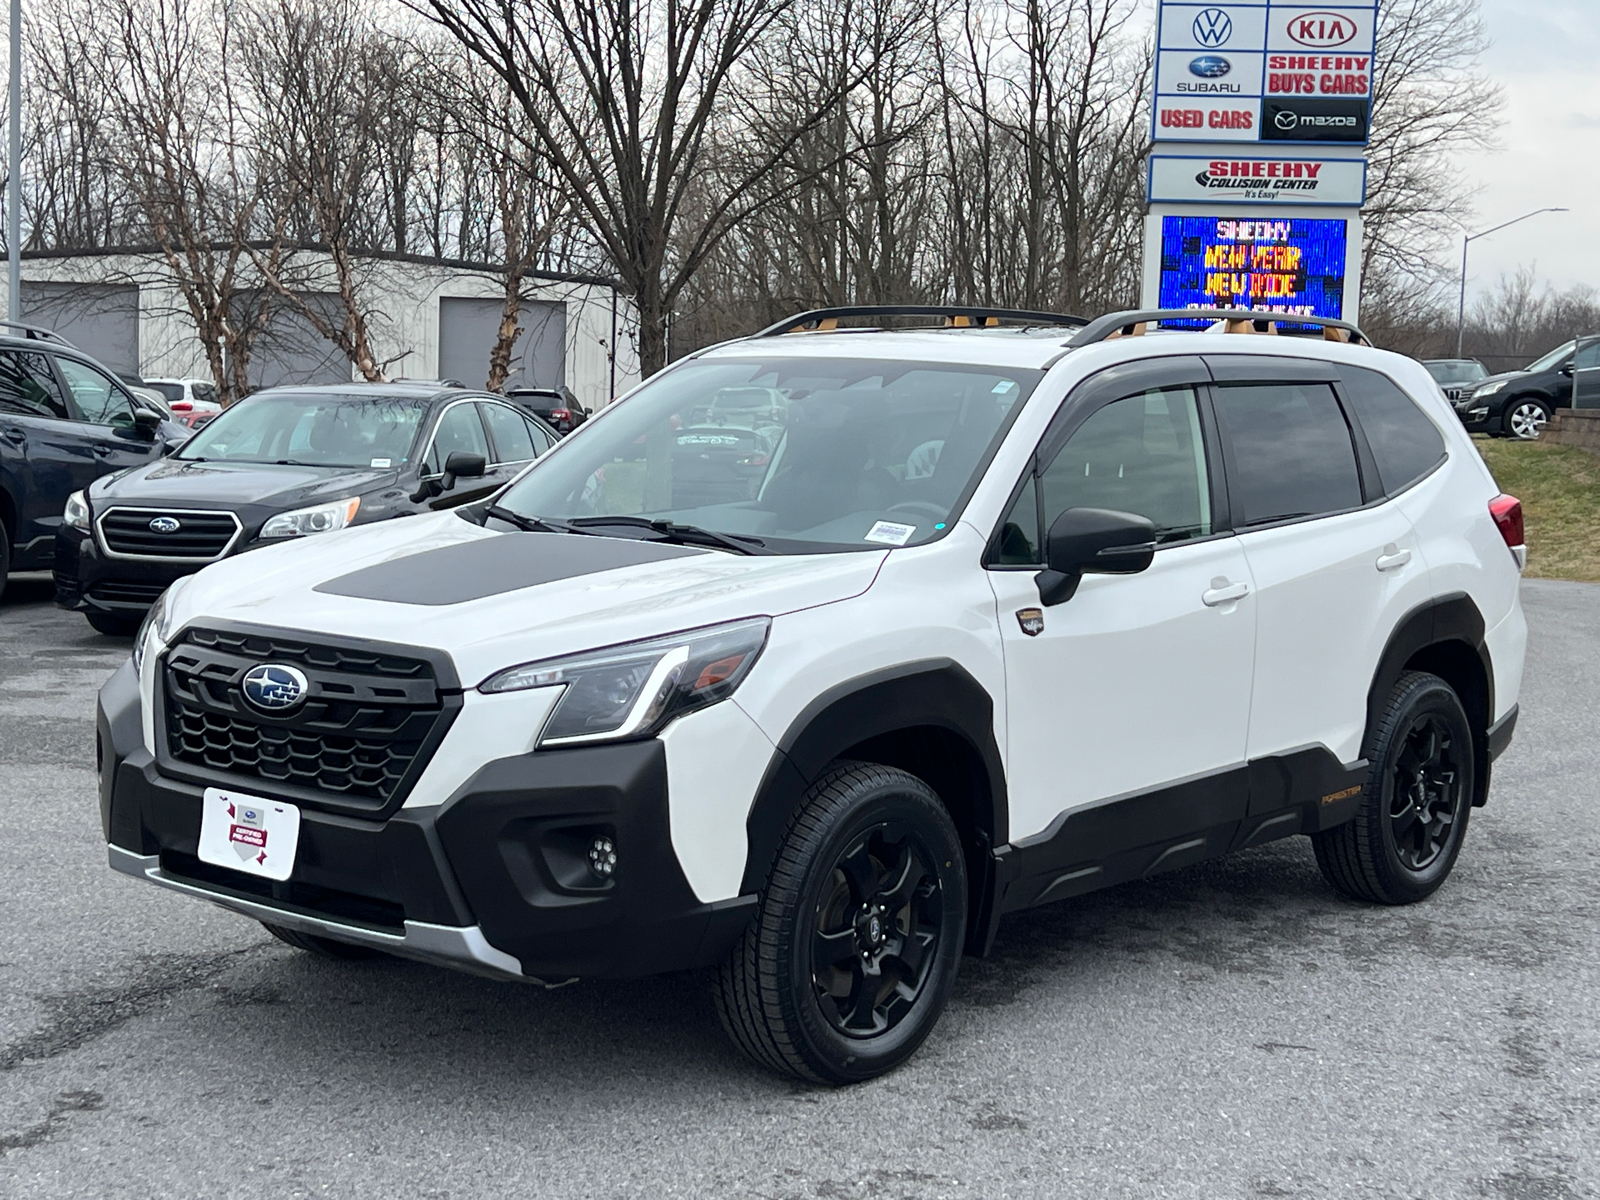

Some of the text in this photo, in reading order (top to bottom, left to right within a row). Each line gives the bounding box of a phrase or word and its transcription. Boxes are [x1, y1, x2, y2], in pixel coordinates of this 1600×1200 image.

[1299, 20, 1344, 40] KIA
[1269, 56, 1369, 71] SHEEHY
[1176, 82, 1241, 93] SUBARU
[1268, 73, 1369, 94] BUYS CARS
[1161, 109, 1253, 129] USED CARS
[1209, 161, 1322, 178] SHEEHY
[1208, 178, 1319, 190] COLLISION CENTER
[1244, 190, 1279, 200] It's Easy!
[1216, 220, 1290, 241] SHEEHY
[1204, 245, 1302, 270] NEW YEAR
[1204, 272, 1246, 297] NEW
[1321, 784, 1362, 805] FORESTER
[232, 832, 264, 845] PRE-OWNED
[235, 827, 262, 839] CERTIFIED
